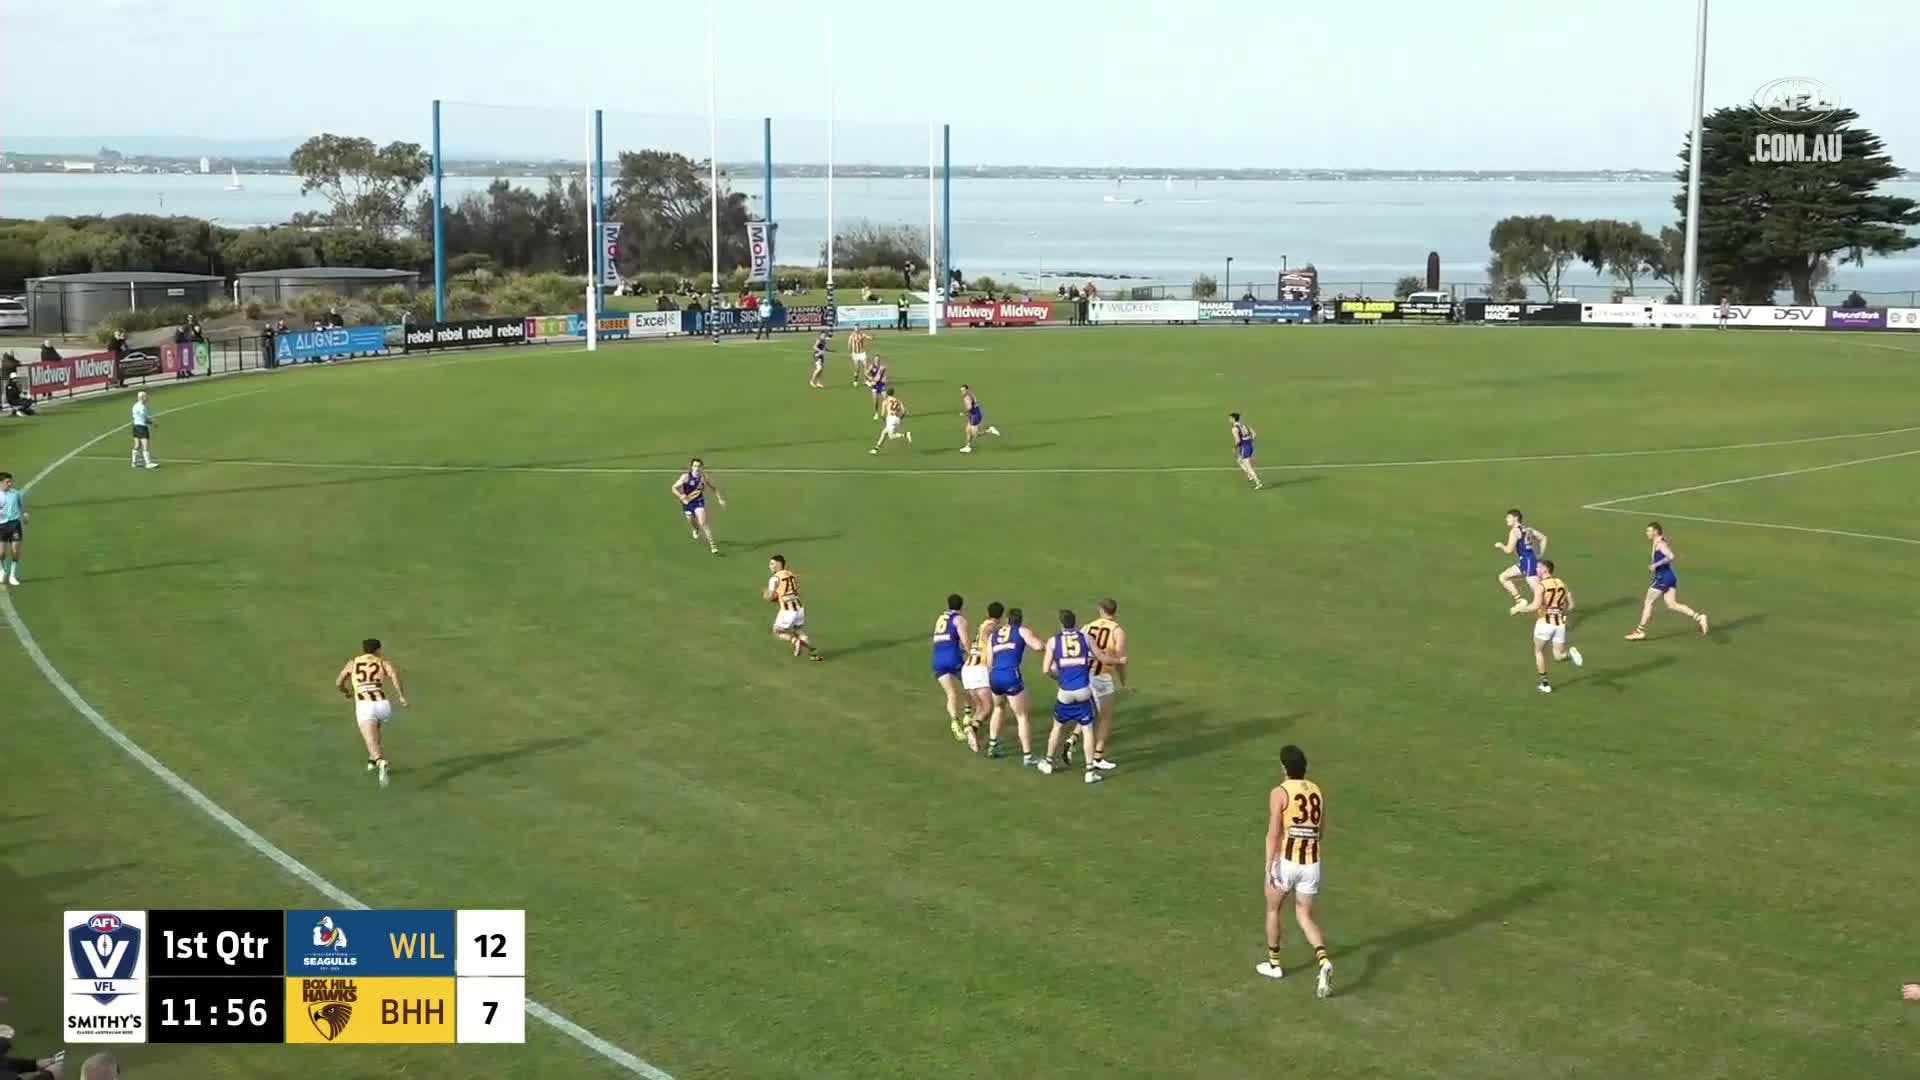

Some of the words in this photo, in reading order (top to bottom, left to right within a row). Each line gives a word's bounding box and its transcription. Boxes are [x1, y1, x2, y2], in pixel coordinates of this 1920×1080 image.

[751, 227, 768, 277] Mobil
[636, 313, 668, 327] Excel
[946, 305, 995, 320] Midway
[1000, 304, 1048, 319] Midway
[1774, 308, 1814, 320] DSV
[295, 330, 350, 350] ALIGNED
[407, 329, 434, 344] rebel
[437, 328, 463, 341] rebel
[467, 325, 493, 339] rebel
[497, 323, 523, 337] rebel
[31, 364, 71, 386] Midway
[75, 358, 115, 378] Midway
[1547, 587, 1565, 608] 72
[935, 614, 949, 634] 6
[997, 626, 1010, 643] 9
[1061, 634, 1081, 658] 15
[356, 662, 381, 683] 52
[1292, 793, 1321, 825] 38
